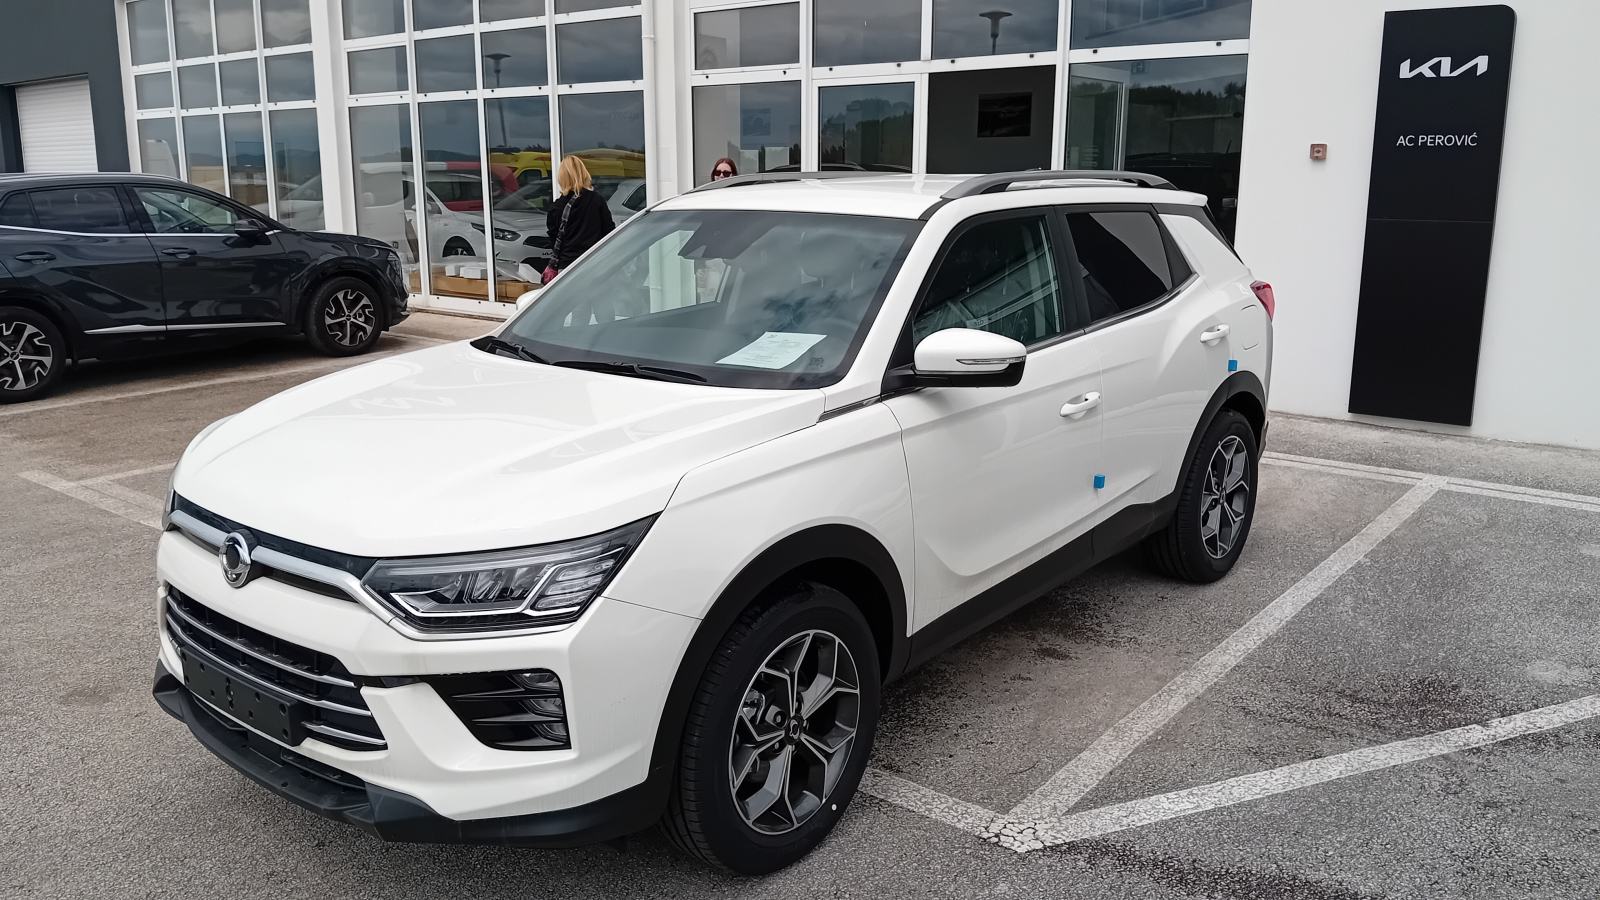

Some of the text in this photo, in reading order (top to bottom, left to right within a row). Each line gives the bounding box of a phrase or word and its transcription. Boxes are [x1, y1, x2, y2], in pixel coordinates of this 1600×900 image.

[1399, 55, 1489, 79] KIA
[1396, 132, 1478, 147] AC PEROVIĆ
